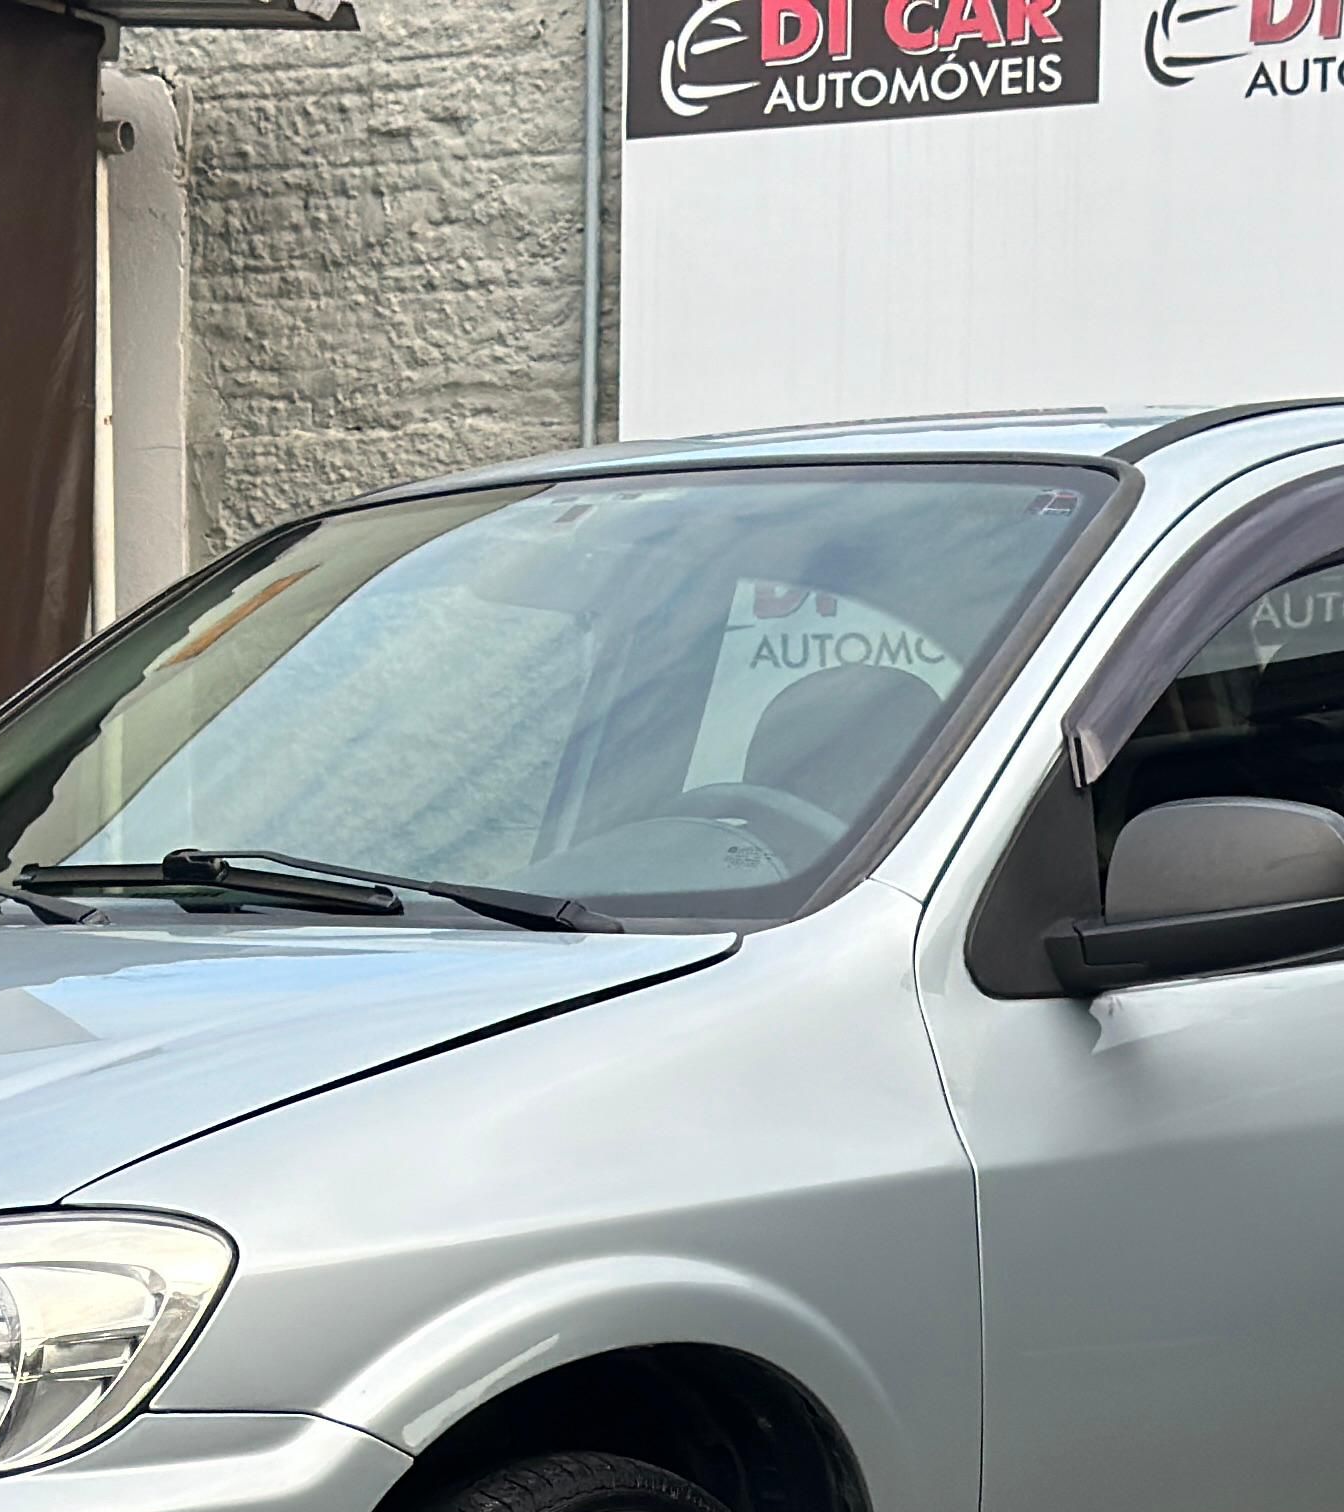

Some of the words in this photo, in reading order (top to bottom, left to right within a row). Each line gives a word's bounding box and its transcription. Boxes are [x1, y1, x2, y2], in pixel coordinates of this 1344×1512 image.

[760, 0, 853, 67] DI
[883, 0, 1063, 55] CAR
[763, 53, 1063, 115] AUTOMÓVEIS
